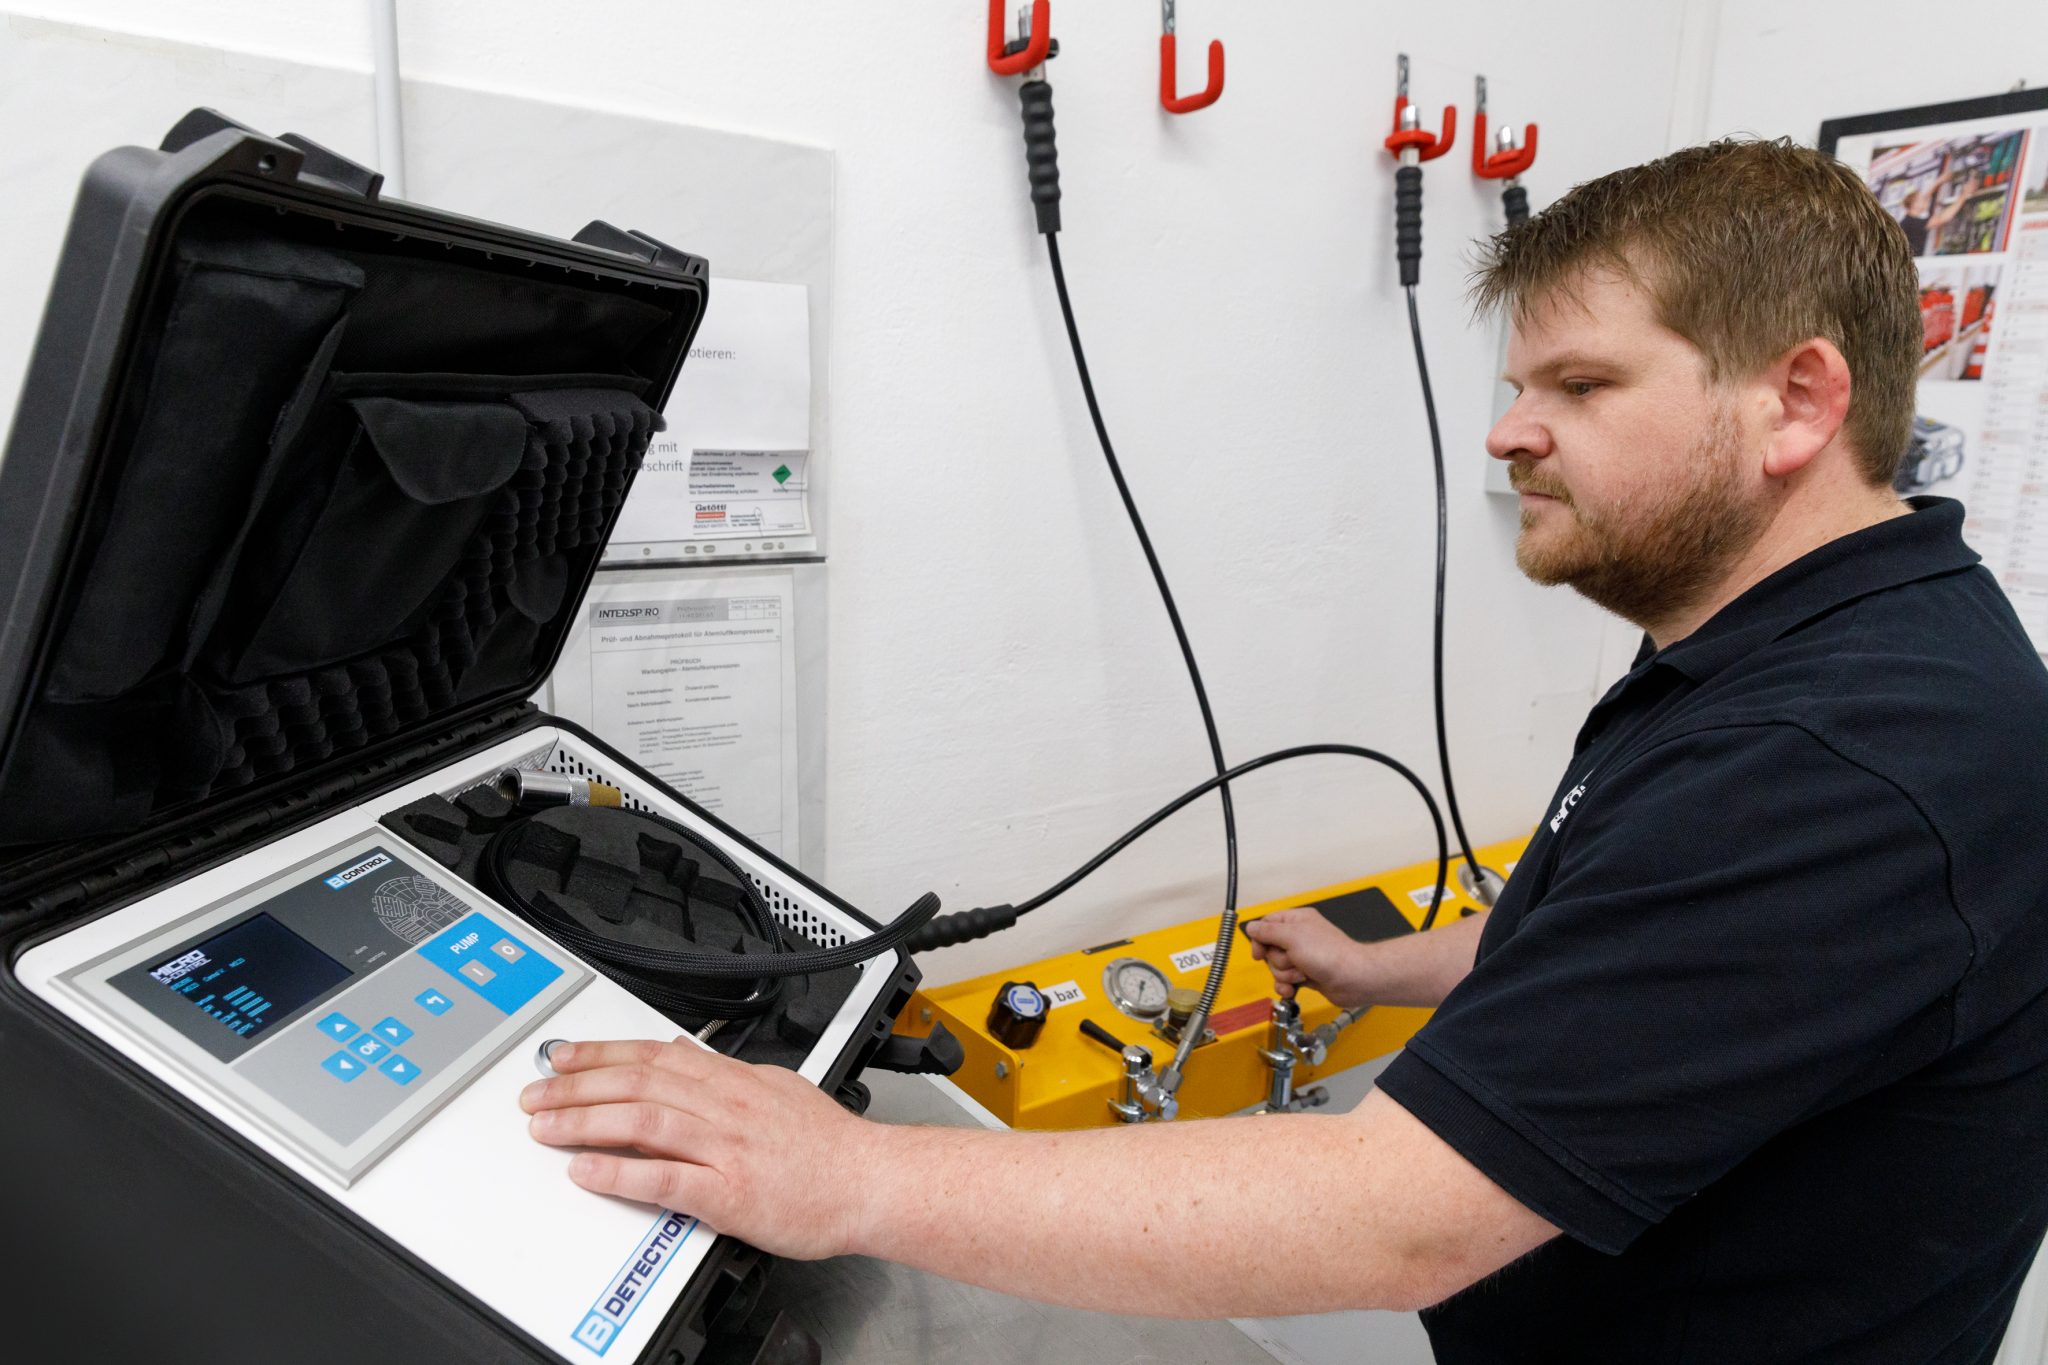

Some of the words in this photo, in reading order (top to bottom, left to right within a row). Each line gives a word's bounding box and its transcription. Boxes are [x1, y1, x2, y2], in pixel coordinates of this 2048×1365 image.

[658, 441, 678, 454] mit
[599, 607, 660, 618] INTERSPRO
[342, 854, 387, 881] CONTROL
[450, 932, 479, 954] PUMP
[150, 949, 206, 980] MICRO
[1175, 953, 1200, 969] 200
[1054, 988, 1079, 1002] bar
[360, 1039, 381, 1055] OK
